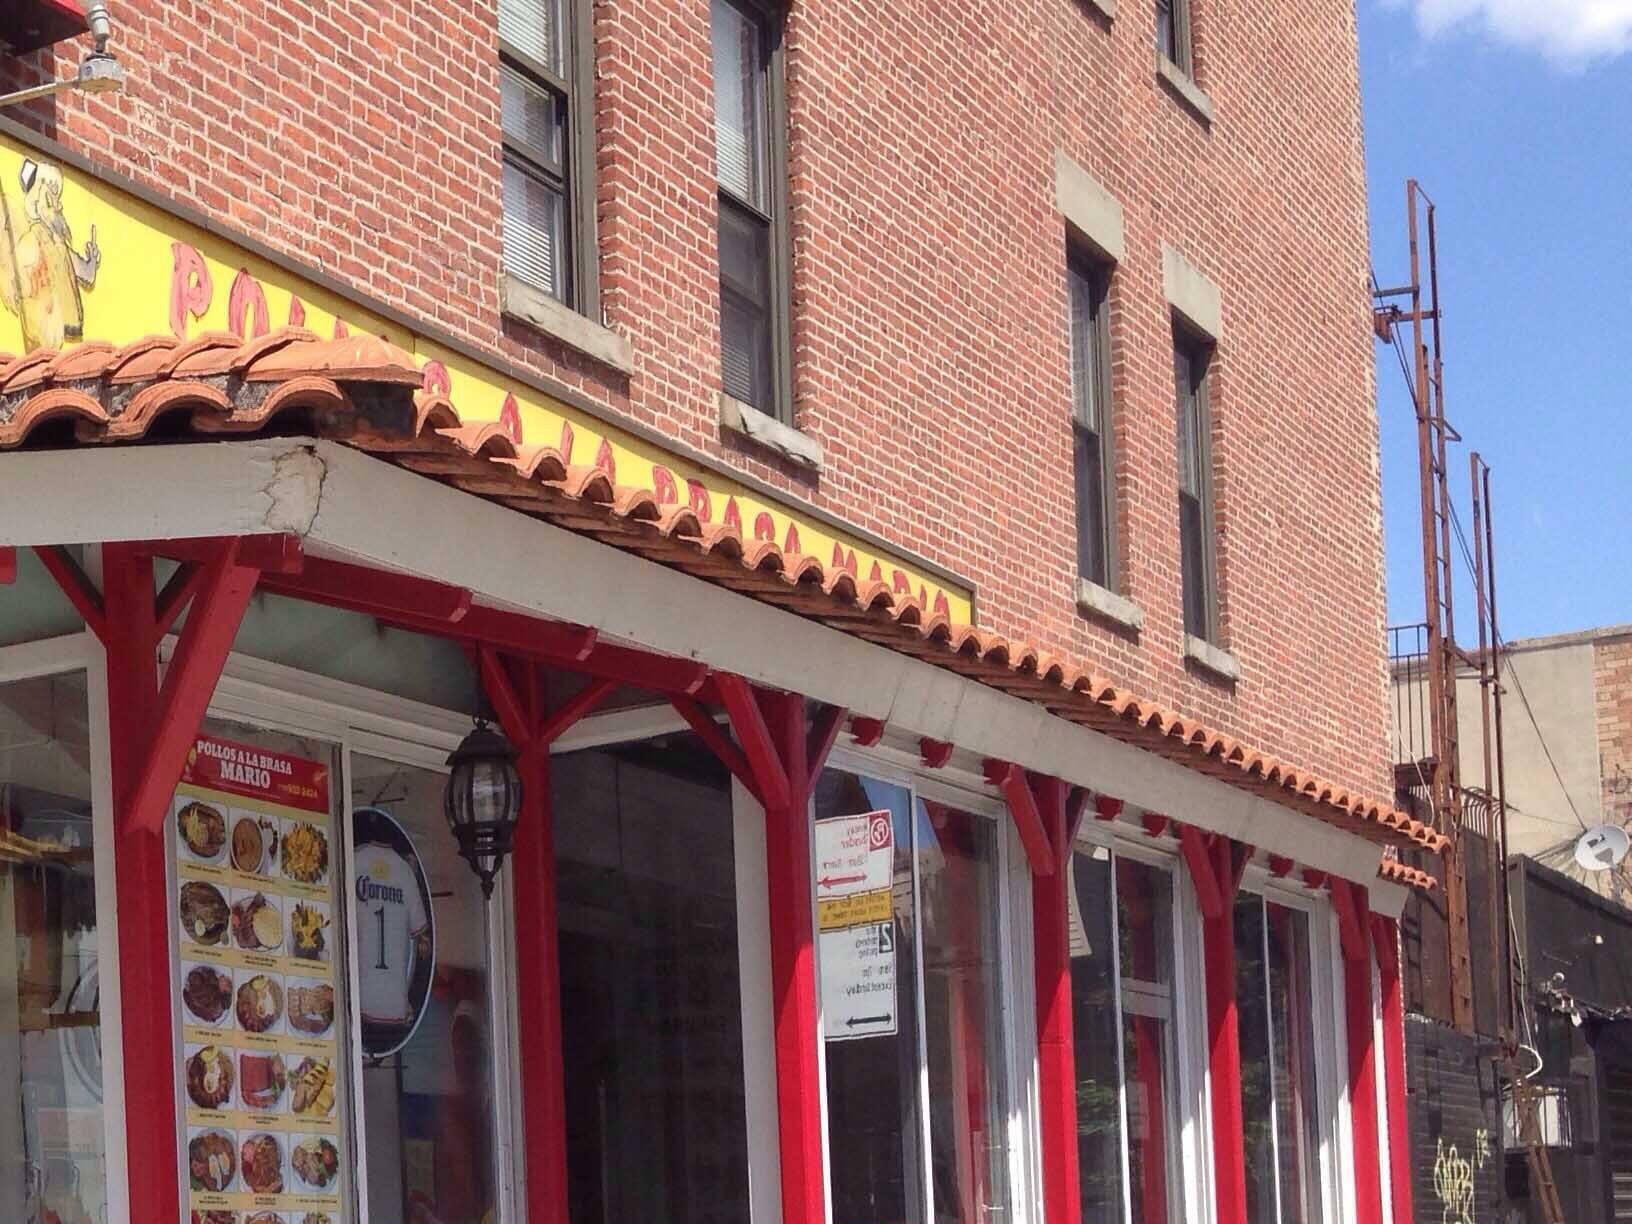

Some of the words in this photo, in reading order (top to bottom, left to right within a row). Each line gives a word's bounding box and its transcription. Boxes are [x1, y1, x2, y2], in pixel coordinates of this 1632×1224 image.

[196, 740, 236, 762] POLLOS
[237, 751, 245, 765] A
[246, 752, 259, 768] LA
[259, 755, 293, 775] BRASA
[220, 760, 271, 789] MARIO
[355, 875, 404, 905] Corona
[373, 906, 389, 970] 1
